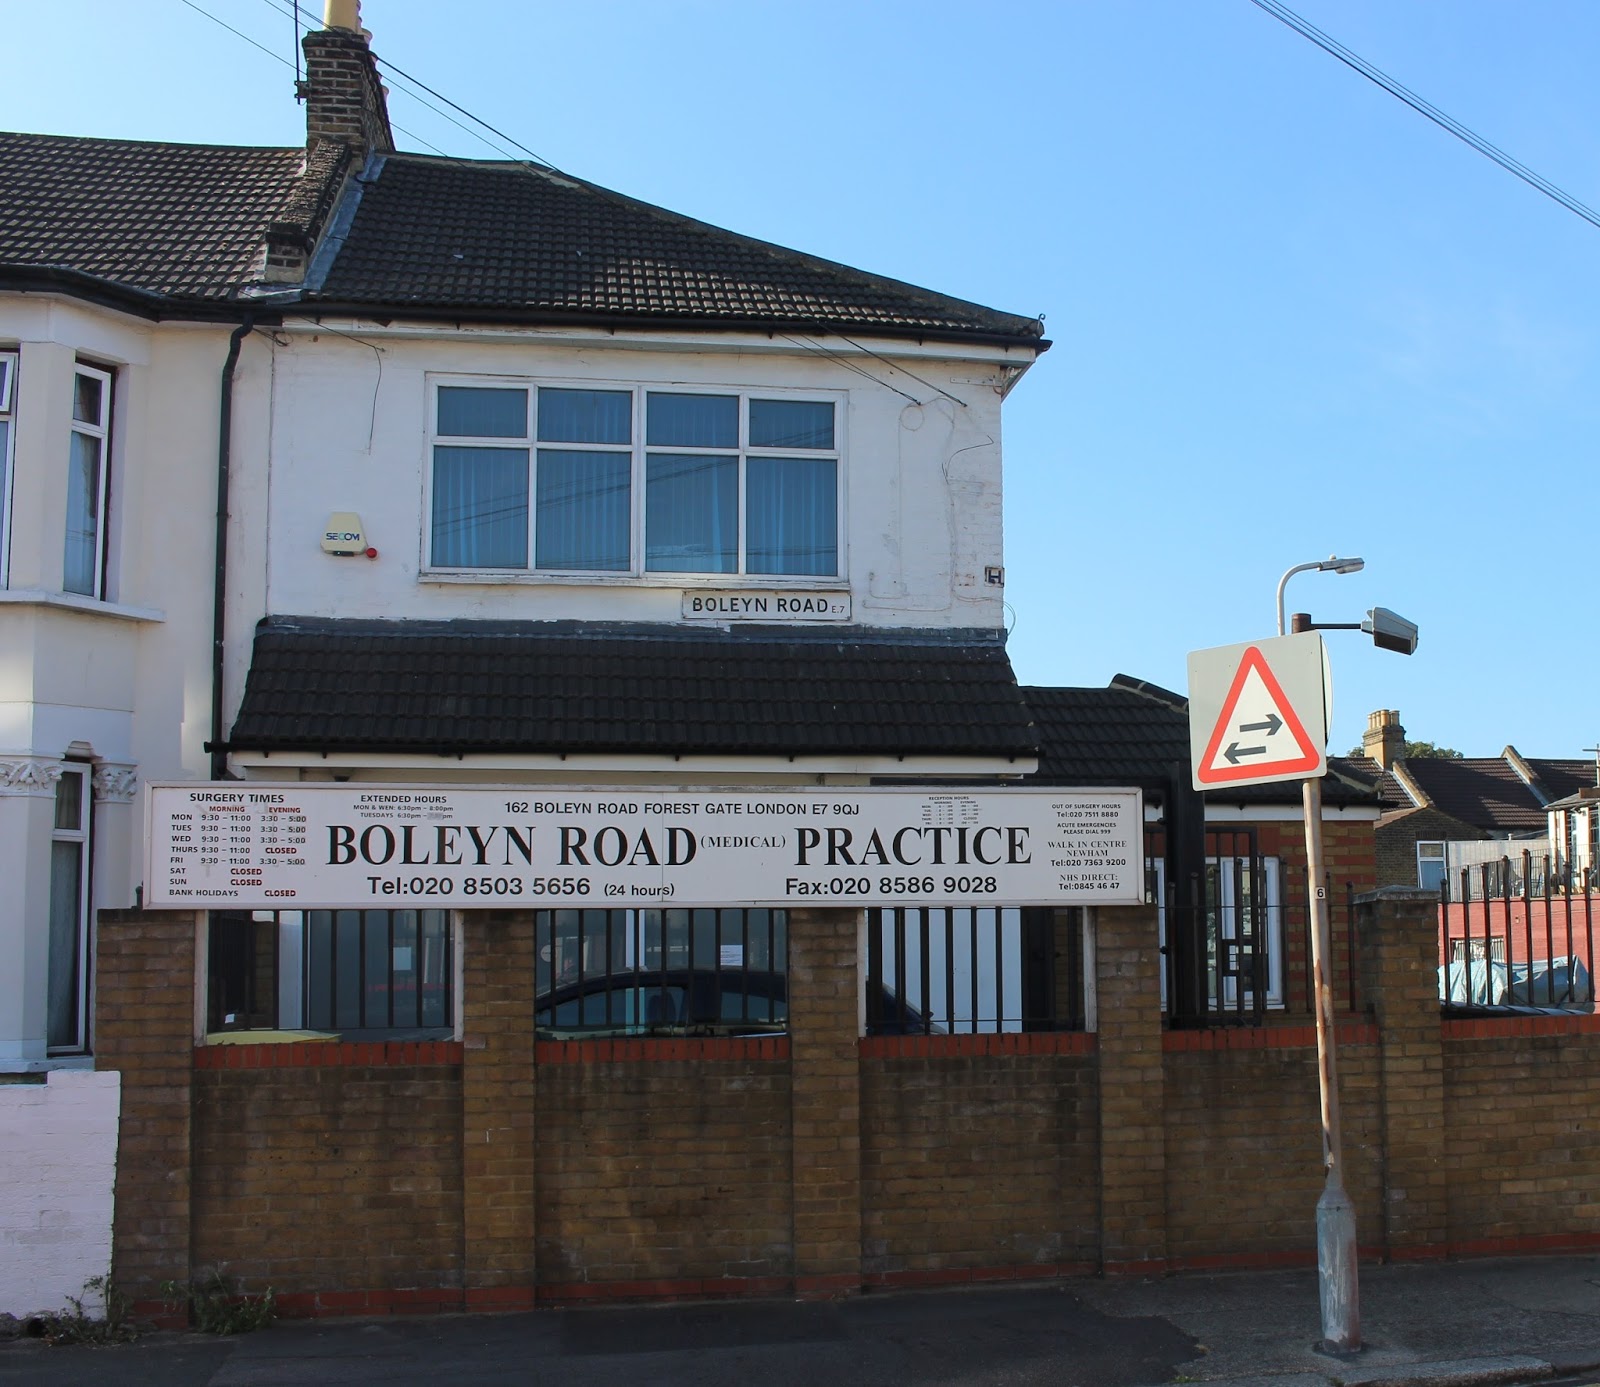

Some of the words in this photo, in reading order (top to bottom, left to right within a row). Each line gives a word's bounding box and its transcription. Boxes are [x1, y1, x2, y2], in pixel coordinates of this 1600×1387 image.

[326, 532, 360, 541] SECOM
[692, 597, 768, 612] BOLEYN
[777, 598, 828, 613] ROAD
[190, 793, 244, 803] SURGERY
[249, 794, 284, 803] TIMES
[360, 794, 411, 803] EXTENDED
[414, 795, 447, 803] HOURS
[505, 802, 529, 813] 162
[534, 802, 591, 814] BOLEYN
[598, 803, 638, 814] ROAD
[644, 803, 700, 814] FOREST
[705, 803, 742, 815] GATE
[747, 803, 806, 815] LONDON
[812, 804, 828, 815] E7
[833, 804, 859, 815] 9QJ
[171, 824, 192, 832] TUES
[325, 824, 536, 866] BOLEYN
[556, 826, 697, 866] ROAD
[700, 835, 786, 849] (MEDICAL)
[794, 826, 1032, 866] PRACTICE
[1090, 840, 1127, 848] CENTRE
[1066, 849, 1108, 857] NEWHAM
[1051, 859, 1082, 867] Tel:020
[230, 868, 263, 876] CLOSED
[1081, 873, 1118, 881] DIRECT:
[367, 877, 454, 895] Tel:020
[463, 877, 523, 895] 8503
[532, 878, 591, 895] 5656
[604, 883, 626, 896] (24
[631, 883, 675, 896] hours)
[786, 877, 871, 895] Fax:020
[879, 876, 935, 894] 8586
[943, 876, 997, 894] 9028
[196, 889, 239, 897] HOLIDAYS
[1317, 888, 1324, 898] 6
